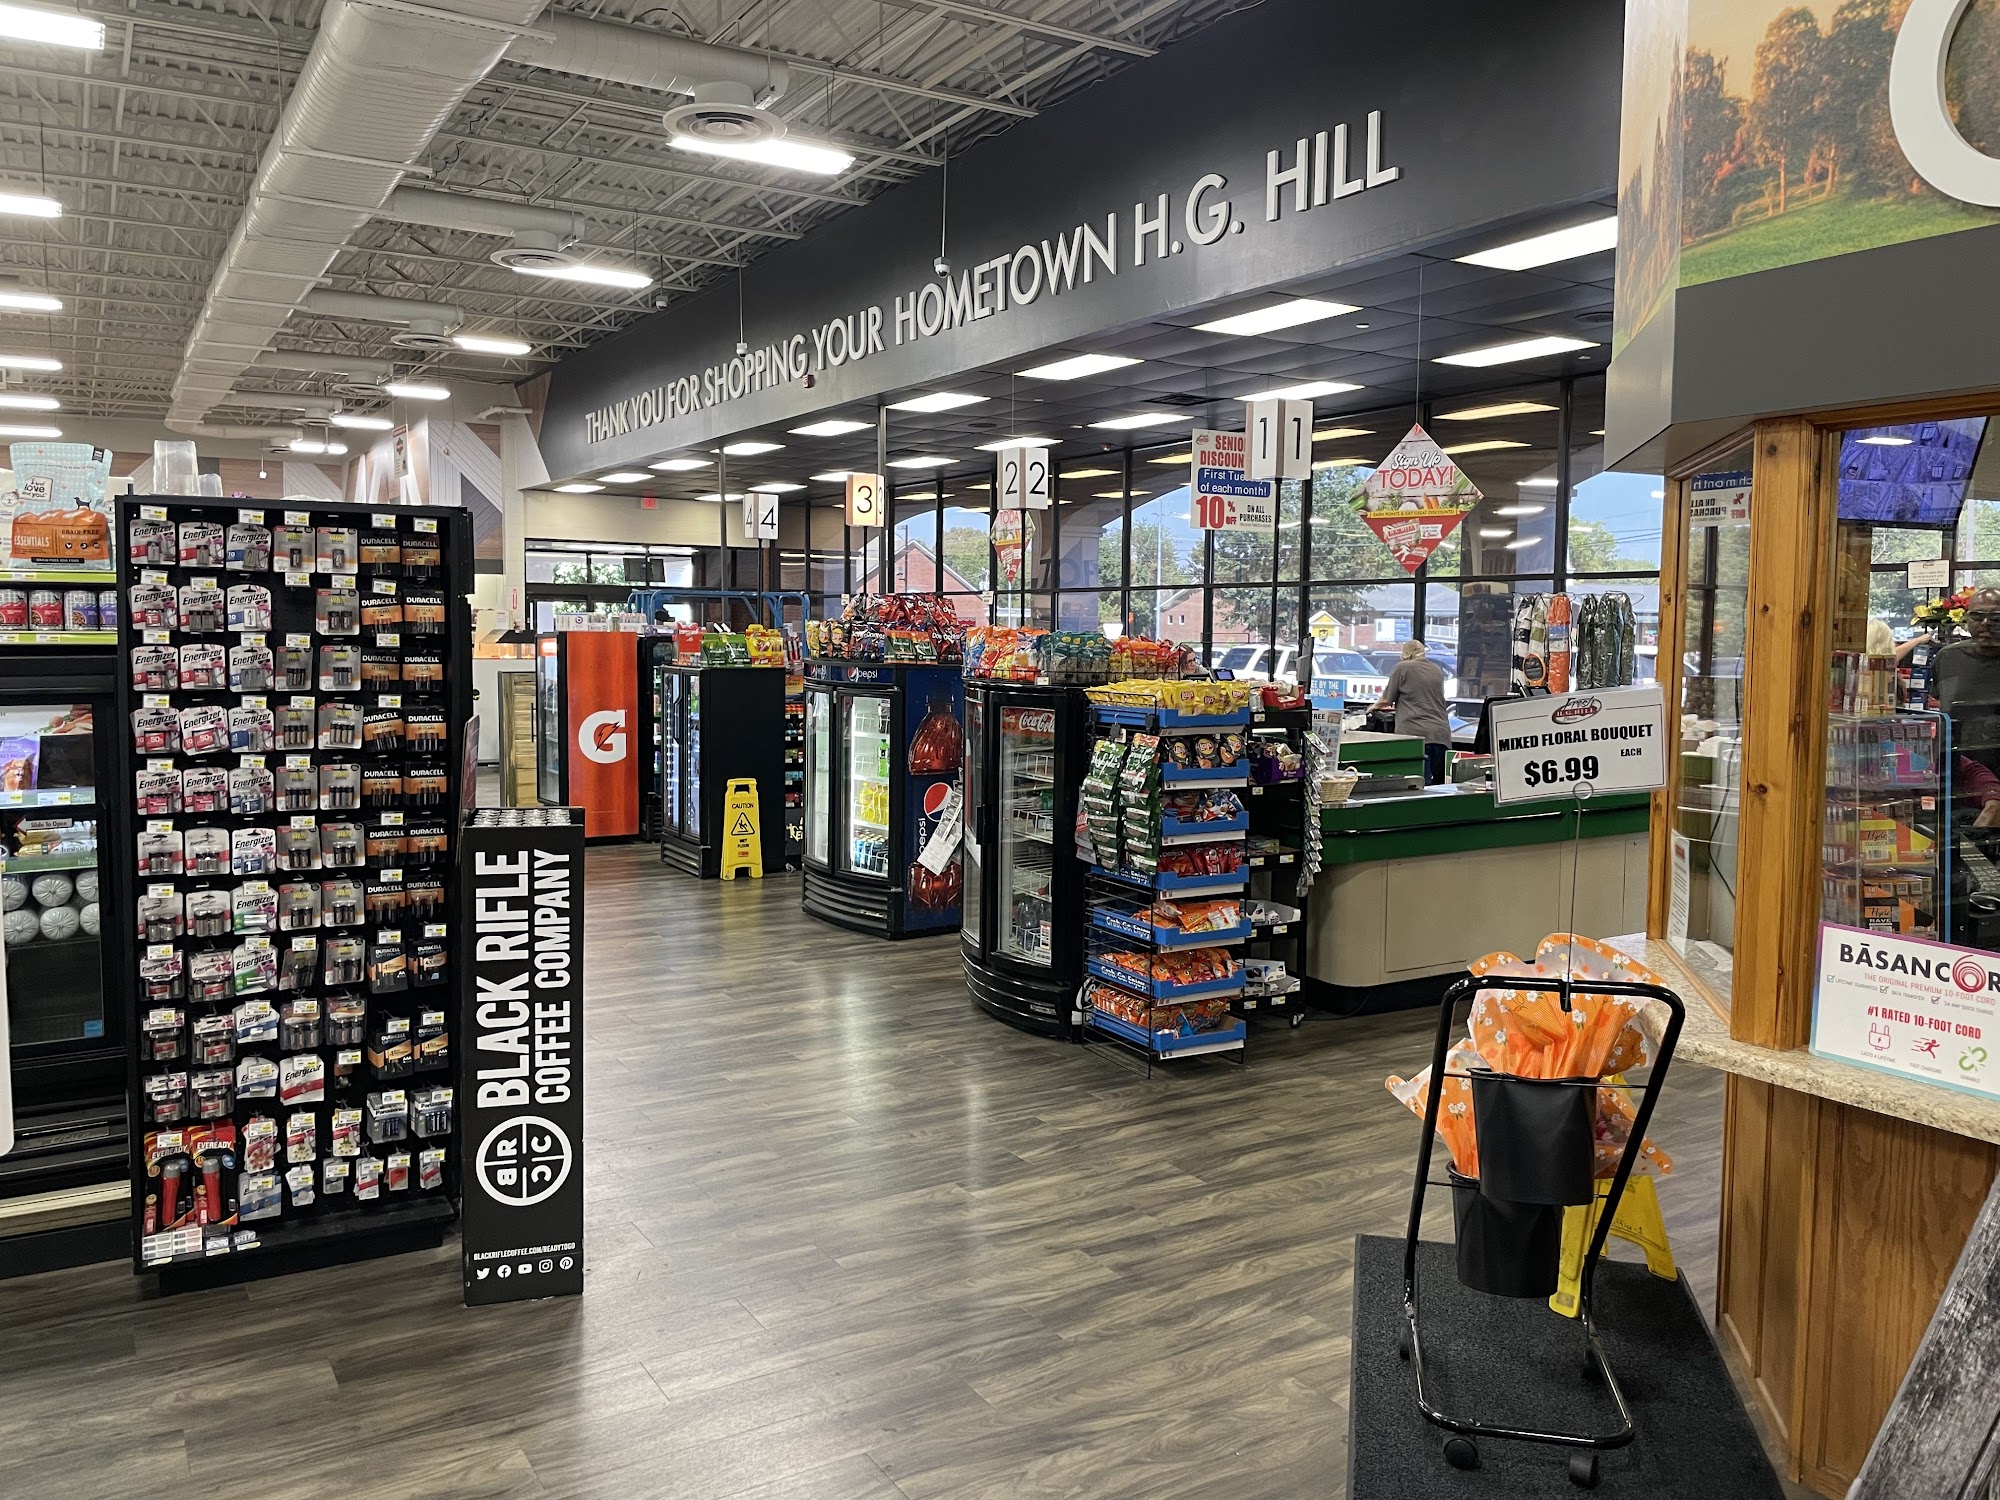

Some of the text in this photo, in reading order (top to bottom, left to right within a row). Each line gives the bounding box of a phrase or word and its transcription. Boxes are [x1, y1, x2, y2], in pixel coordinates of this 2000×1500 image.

[585, 109, 1399, 443] THANK YOU FOR SHOPPING YOUR HOMETOWN H.G. HILL
[1260, 417, 1267, 459] 1
[1293, 417, 1301, 460] 1
[1200, 450, 1245, 468] DISCOUN
[1391, 450, 1441, 470] Sign Up
[1005, 461, 1017, 495] 2
[1029, 462, 1045, 495] 2
[1204, 469, 1225, 479] First
[1378, 465, 1455, 489] TODAY!
[24, 483, 45, 492] love
[1200, 482, 1267, 496] of each month!
[857, 485, 872, 513] 3
[1196, 495, 1225, 529] 10
[1228, 501, 1235, 513] %
[1247, 505, 1264, 513] ON ALL
[761, 505, 776, 529] 4
[1226, 517, 1237, 525] OFF
[1240, 514, 1271, 523] PURCHASES
[134, 524, 173, 536] Energizer
[183, 528, 221, 540] Energizer
[14, 535, 49, 547] ESSENTIALS
[231, 532, 269, 543] Energizer
[134, 590, 174, 603] Energizer
[183, 593, 221, 605] Energizer
[229, 592, 268, 605] Energizer
[361, 598, 397, 606] DURACELL
[135, 651, 175, 664] Energizer
[183, 649, 222, 662] Energizer
[232, 652, 270, 665] Energizer
[1319, 681, 1339, 689] BY THE
[137, 714, 177, 727] Energizer
[184, 711, 220, 729] Energizer
[233, 713, 270, 727] Energizer
[364, 712, 398, 722] DURACELL
[578, 709, 627, 764] G
[1499, 724, 1653, 752] MIXED FLORAL BOUQUET
[1620, 748, 1642, 757] EACH
[1524, 755, 1599, 787] $6.99
[139, 774, 179, 789] Energizer
[186, 773, 225, 787] Energizer
[233, 776, 271, 789] Energizer
[53, 820, 68, 829] Open
[370, 830, 404, 838] DURACELL
[1866, 831, 1887, 841] Hyde
[61, 844, 88, 853] freshpet
[235, 835, 273, 849] Energizer
[368, 885, 402, 893] DURACELL
[407, 881, 441, 889] DURACELL
[236, 895, 275, 909] Energizer
[1869, 907, 1890, 918] Hyde
[236, 952, 273, 970] Energizer
[475, 850, 530, 1108] BLACK RIFLE
[534, 849, 571, 1104] COFFEE COMPANY
[1864, 973, 1996, 1006] THE ORIGINAL PREMIUM 10-FOOT CORD
[1867, 1006, 1981, 1040] #1 RATED 10-FOOT CORD
[197, 1141, 232, 1149] EVEREADY
[152, 1145, 188, 1159] EVEREADY
[474, 1242, 576, 1261] BLACKRIFLECOFFEE.COM/READYTOGO
